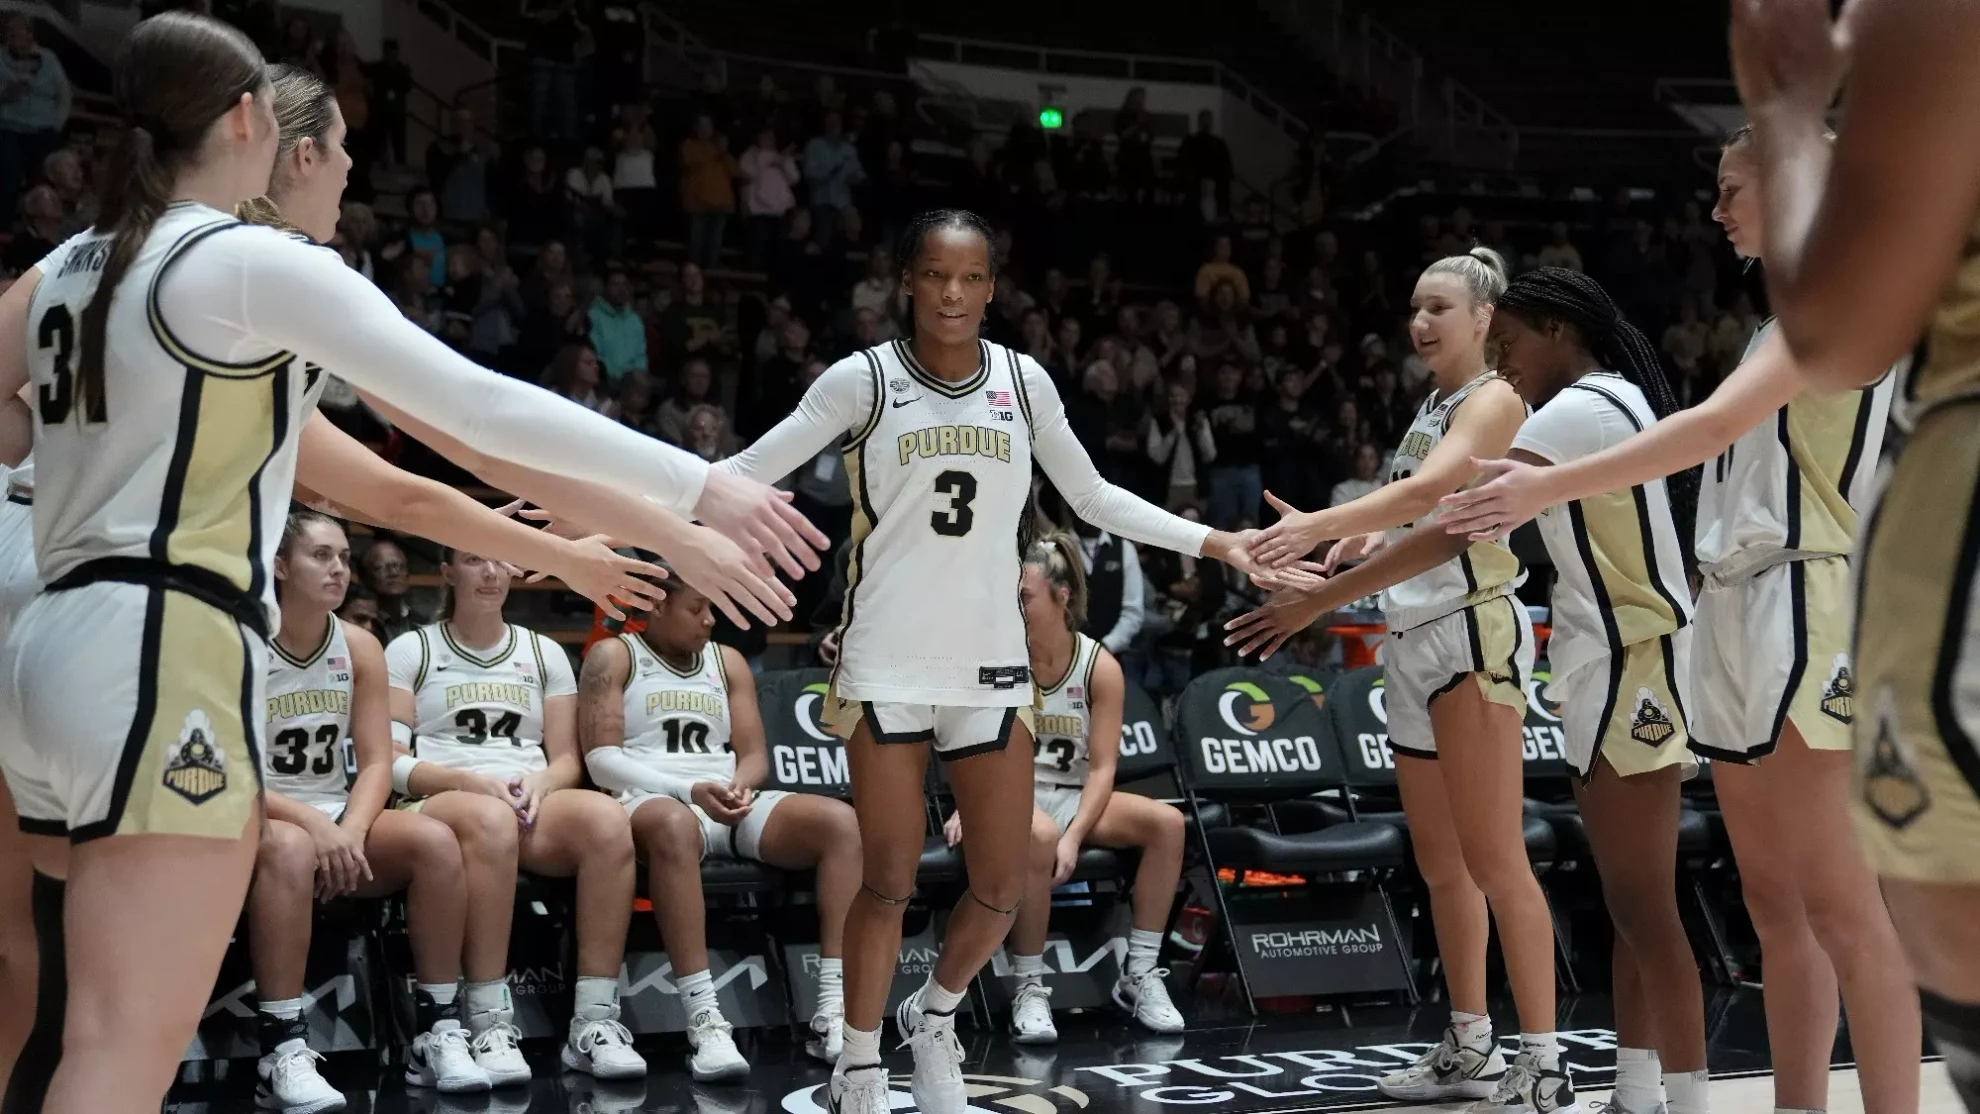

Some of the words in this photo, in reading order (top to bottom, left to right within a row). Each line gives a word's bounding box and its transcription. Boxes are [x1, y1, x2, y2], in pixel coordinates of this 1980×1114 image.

[898, 425, 1011, 466] PURDUE
[930, 470, 978, 537] 3
[266, 689, 348, 724] PURDUE
[446, 683, 531, 710] PURDUE
[646, 690, 723, 721] PURDUE
[455, 709, 522, 747] 34
[662, 718, 712, 753] 10
[1035, 715, 1083, 738] RDUE
[1634, 724, 1672, 741] PURDUE
[272, 724, 339, 775] 33
[773, 744, 850, 785] GEM
[1035, 737, 1075, 772] 3
[1201, 736, 1321, 773] GEMCO
[1251, 923, 1380, 953] ROHRMAN
[1261, 945, 1338, 959] AUTOMOTIVE
[1342, 943, 1383, 955] GROUP
[902, 964, 934, 975] GRO
[516, 984, 567, 996] GROUP
